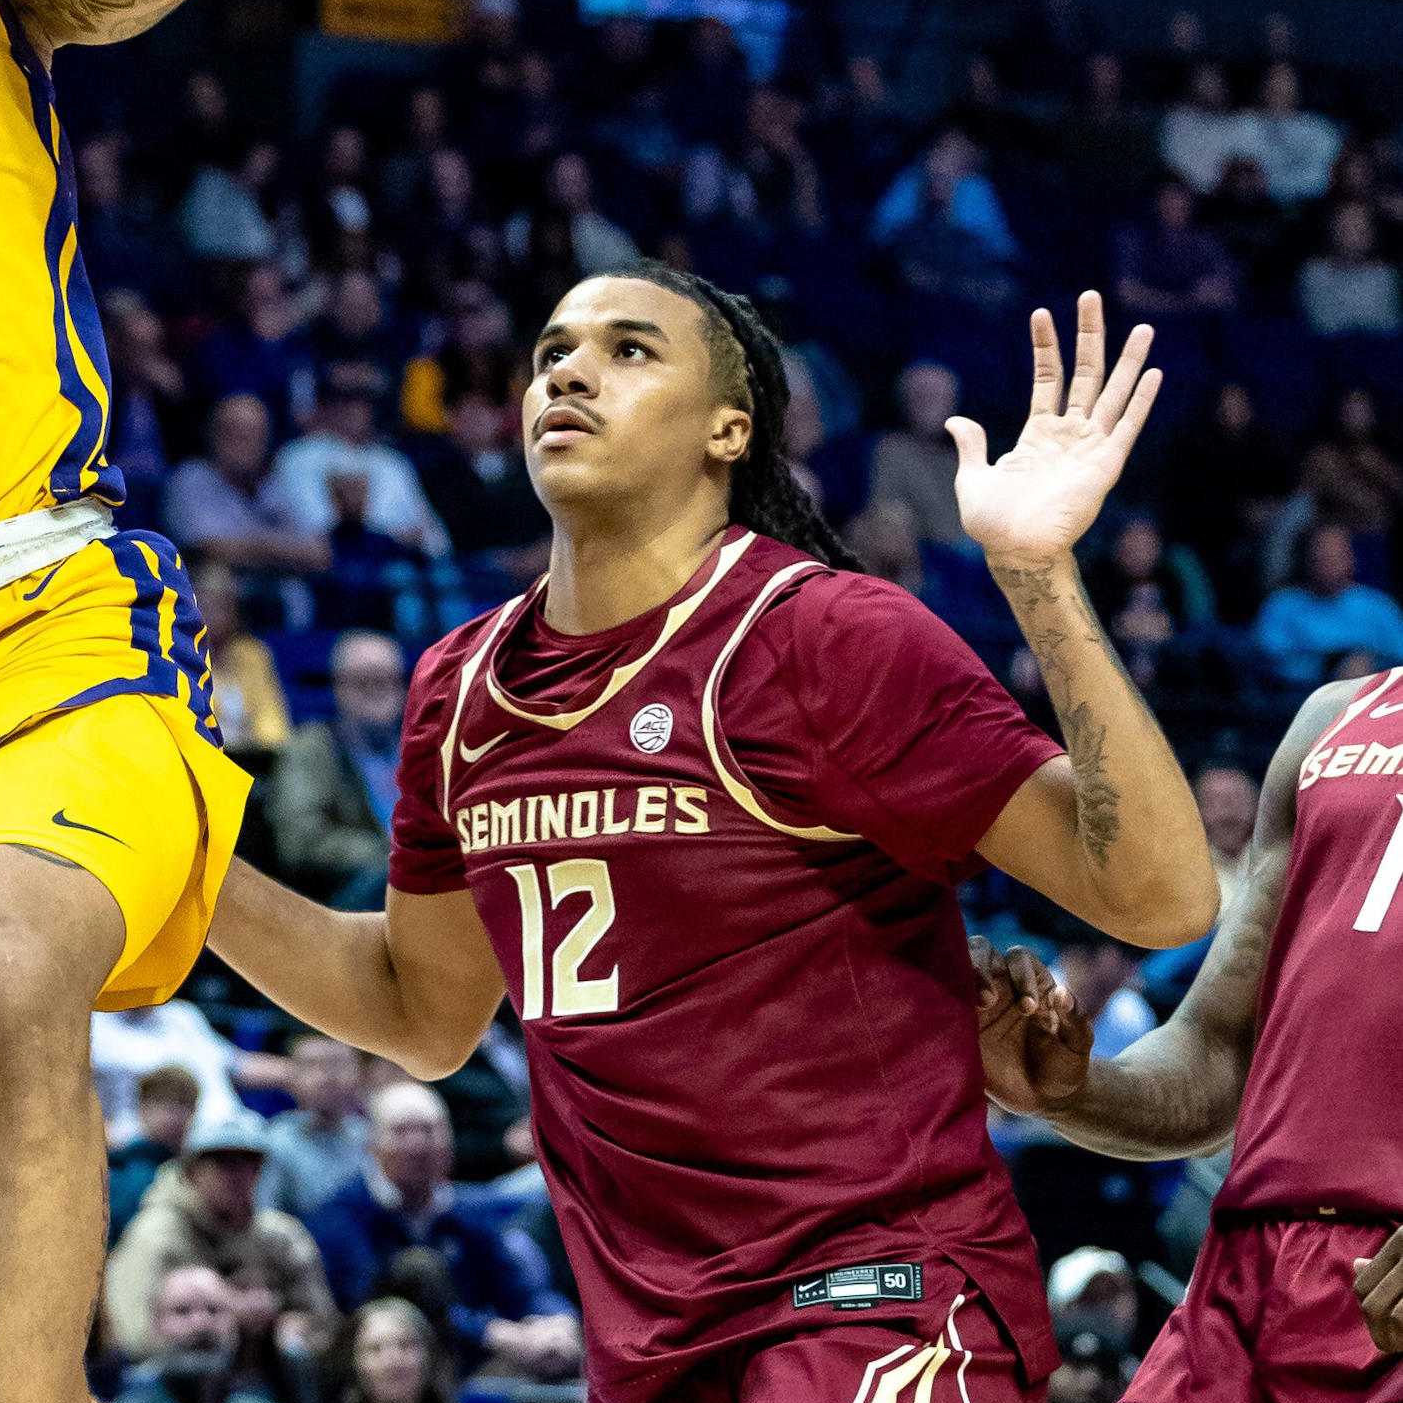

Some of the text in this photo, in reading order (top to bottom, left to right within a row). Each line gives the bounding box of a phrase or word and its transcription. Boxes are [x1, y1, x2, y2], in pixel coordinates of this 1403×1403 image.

[1302, 741, 1403, 790] SEM
[454, 785, 711, 854] SEMINOLES
[505, 858, 620, 1021] 12
[798, 1289, 827, 1300] TEAM
[883, 1272, 907, 1289] 50
